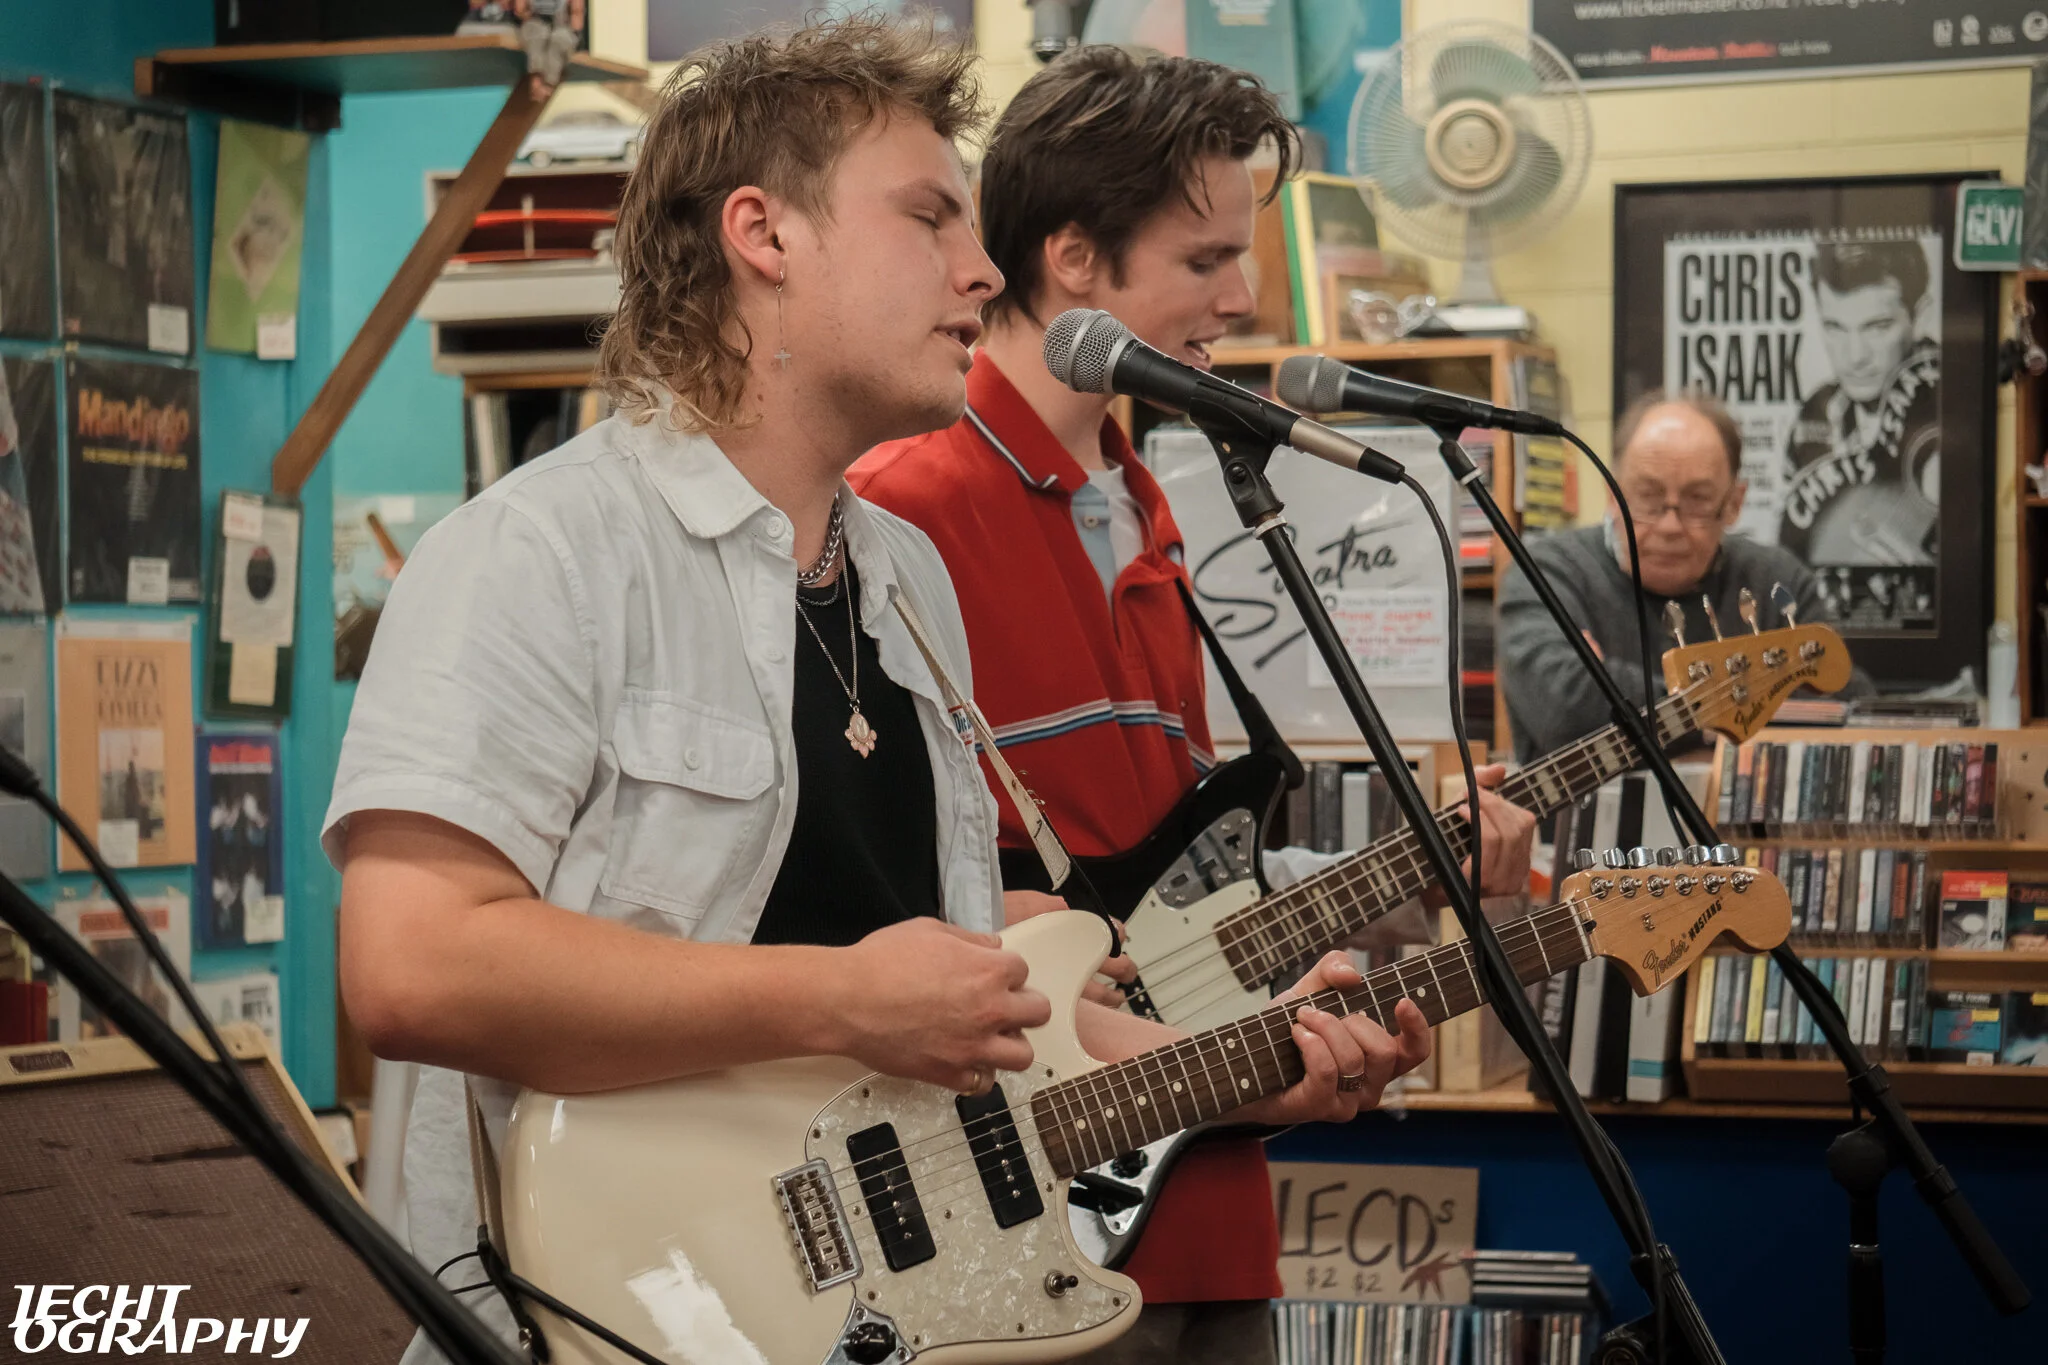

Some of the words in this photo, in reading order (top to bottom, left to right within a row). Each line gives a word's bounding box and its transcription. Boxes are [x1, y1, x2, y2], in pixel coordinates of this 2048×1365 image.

[1681, 250, 1802, 324] CHRIS
[1680, 333, 1802, 403] ISAAK
[1193, 522, 1412, 639] Satra
[1642, 938, 1690, 988] Fender
[1688, 899, 1723, 941] MUSTANG
[1306, 1266, 1337, 1292] $2
[1352, 1271, 1382, 1295] $2
